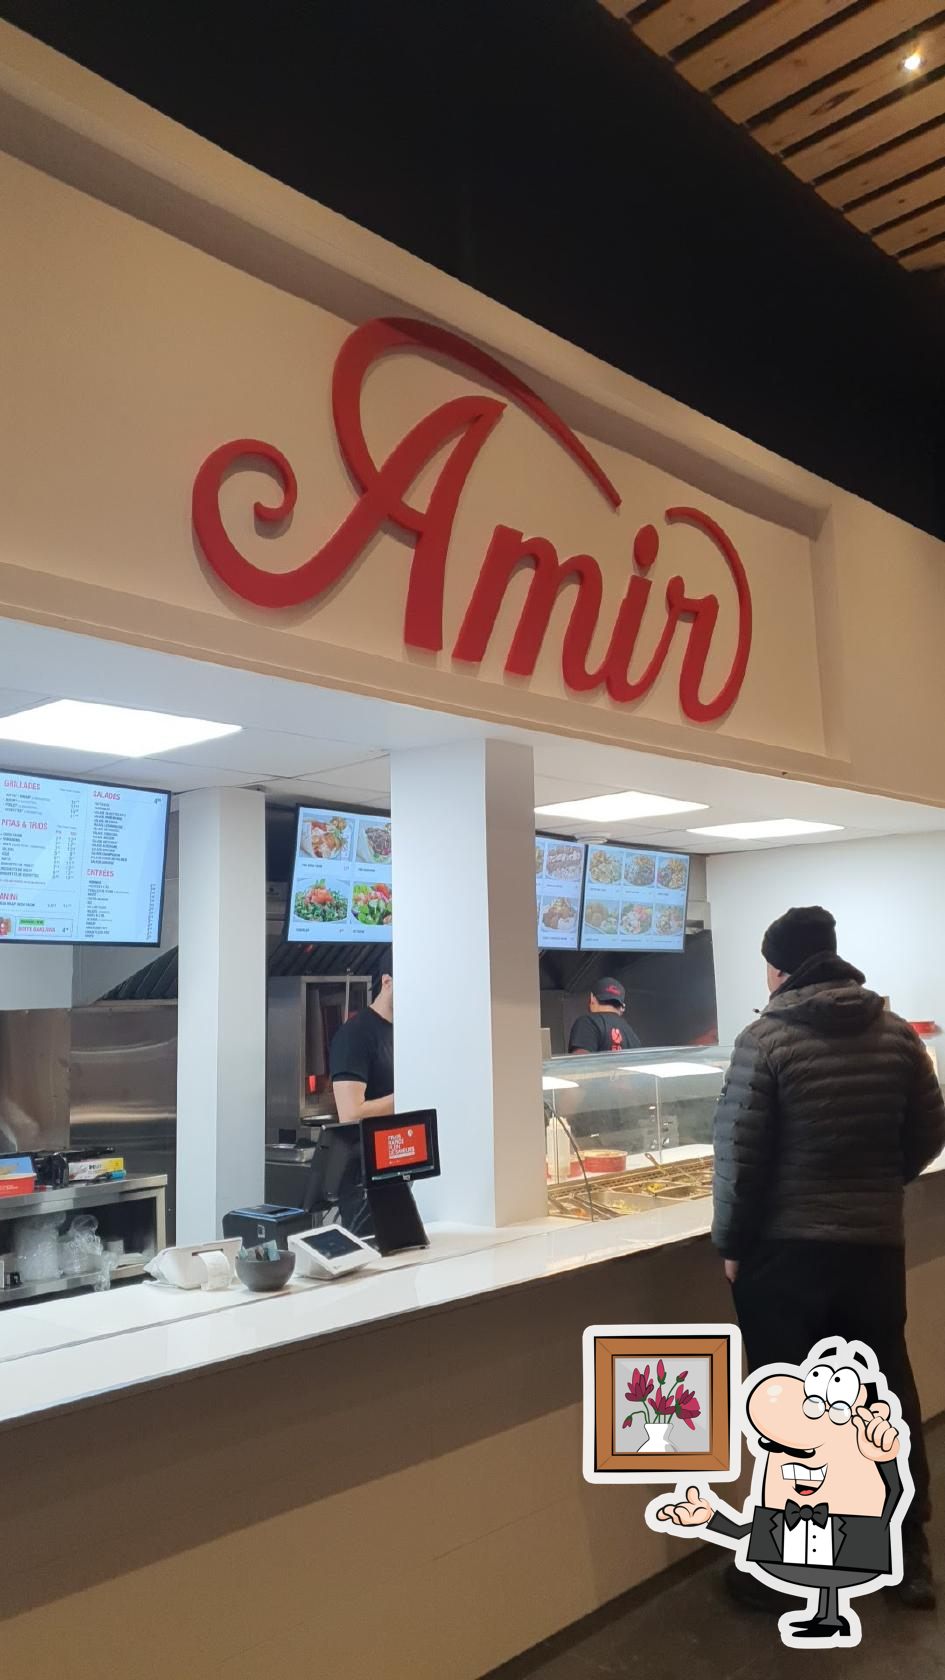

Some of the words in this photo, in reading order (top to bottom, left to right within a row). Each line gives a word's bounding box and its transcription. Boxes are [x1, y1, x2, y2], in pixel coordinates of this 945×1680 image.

[191, 317, 753, 723] Amir
[4, 780, 41, 790] GRILLADES
[93, 791, 121, 800] SALADES
[1, 819, 20, 828] PITAS
